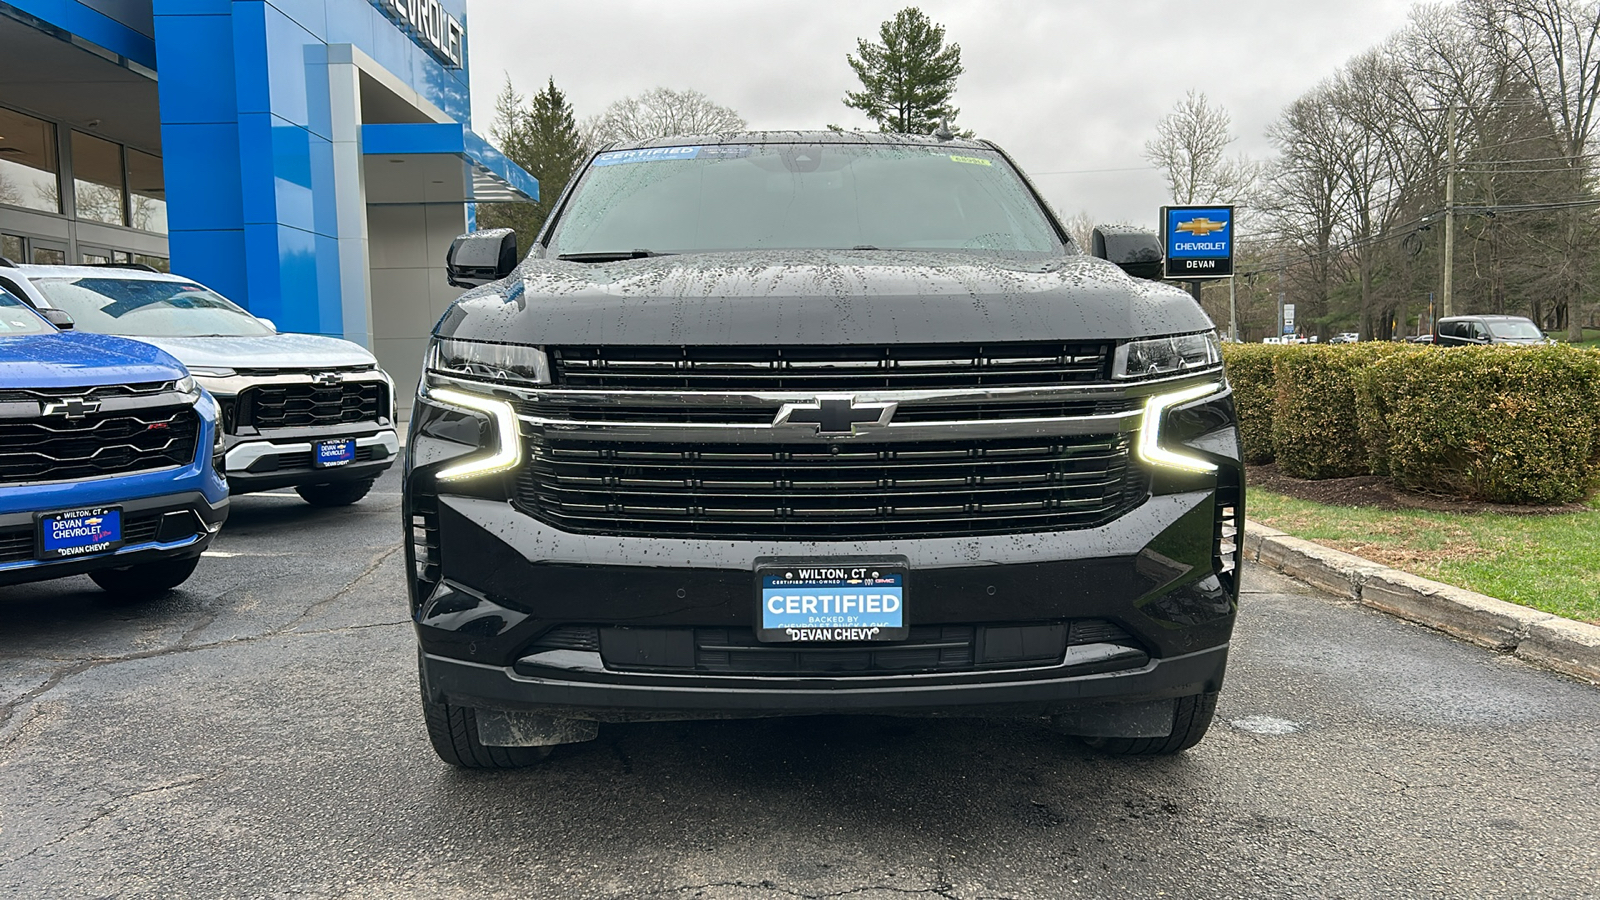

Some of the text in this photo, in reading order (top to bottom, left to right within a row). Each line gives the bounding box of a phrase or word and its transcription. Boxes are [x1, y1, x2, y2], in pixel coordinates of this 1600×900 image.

[601, 148, 694, 160] CERTIFIED
[1175, 242, 1226, 250] CHEVROLET
[1186, 260, 1215, 268] DEVAN
[53, 519, 82, 530] DEVAN
[53, 526, 101, 539] CHEVROLET
[61, 543, 106, 556] DEVAN CHEVY
[798, 568, 866, 579] WILTON, CT
[767, 594, 900, 614] CERTIFIED
[792, 628, 873, 640] DEVAN CHEVY
